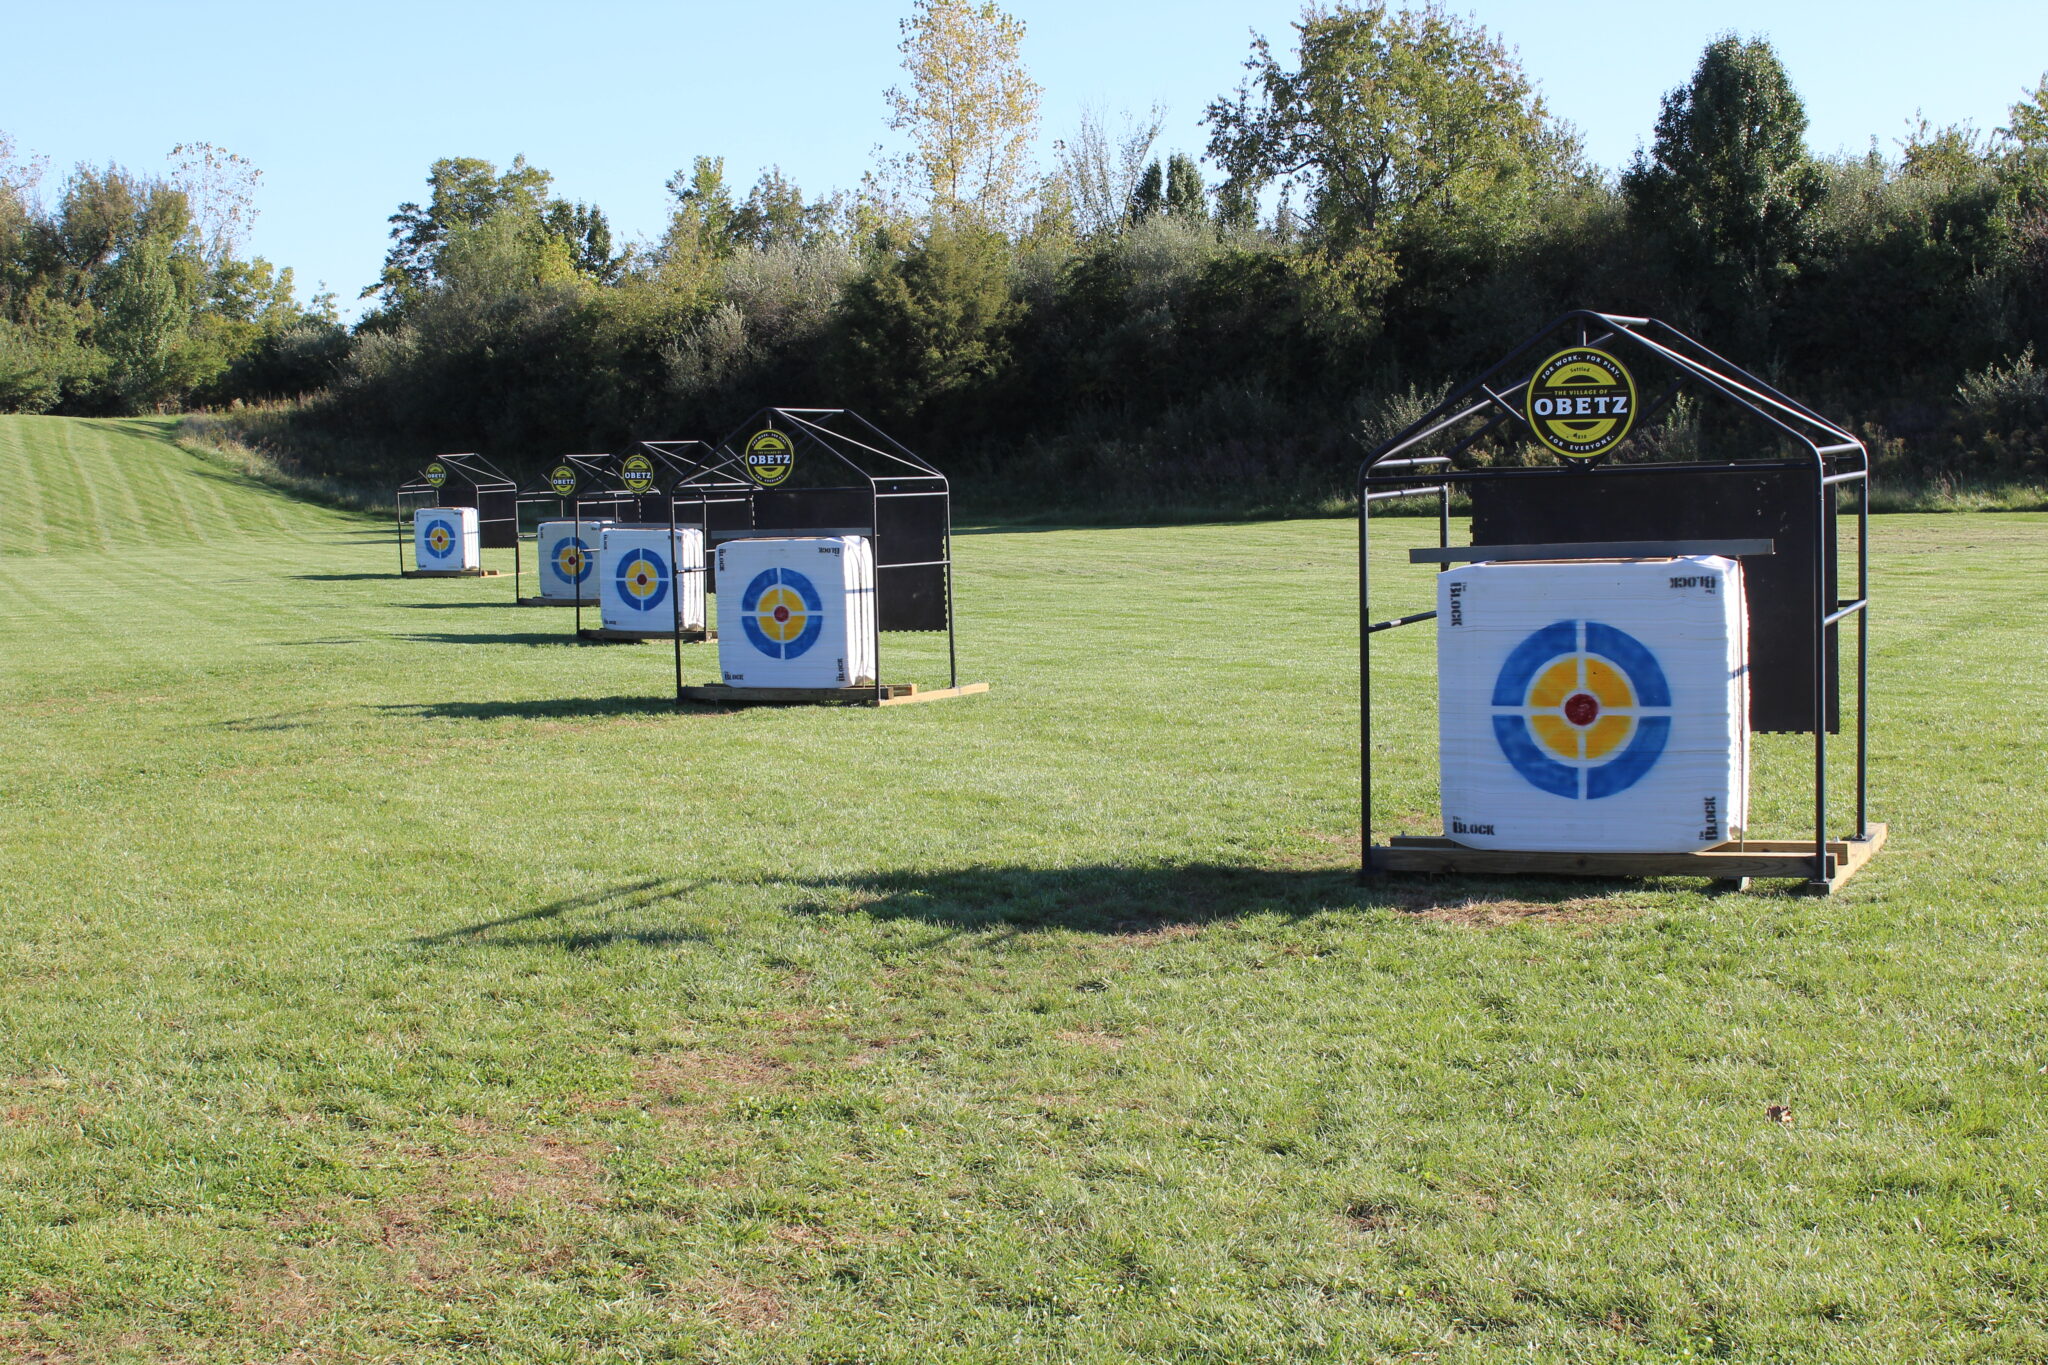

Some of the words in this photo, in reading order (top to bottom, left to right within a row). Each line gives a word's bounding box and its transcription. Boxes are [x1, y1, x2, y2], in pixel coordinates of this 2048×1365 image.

[1541, 367, 1554, 380] FOR
[1555, 354, 1582, 367] WORK.
[1586, 354, 1601, 363] FOR
[1603, 361, 1620, 378] PLAY.
[1534, 396, 1628, 416] OBETZ
[1548, 435, 1564, 447] FOR
[1569, 435, 1615, 451] EVERYONE.
[748, 454, 791, 465] OBETZ
[1669, 575, 1716, 588] BLOCK
[1450, 582, 1462, 626] BLOCK
[1704, 796, 1718, 840] BLOCK
[1453, 821, 1495, 836] BLOCK
